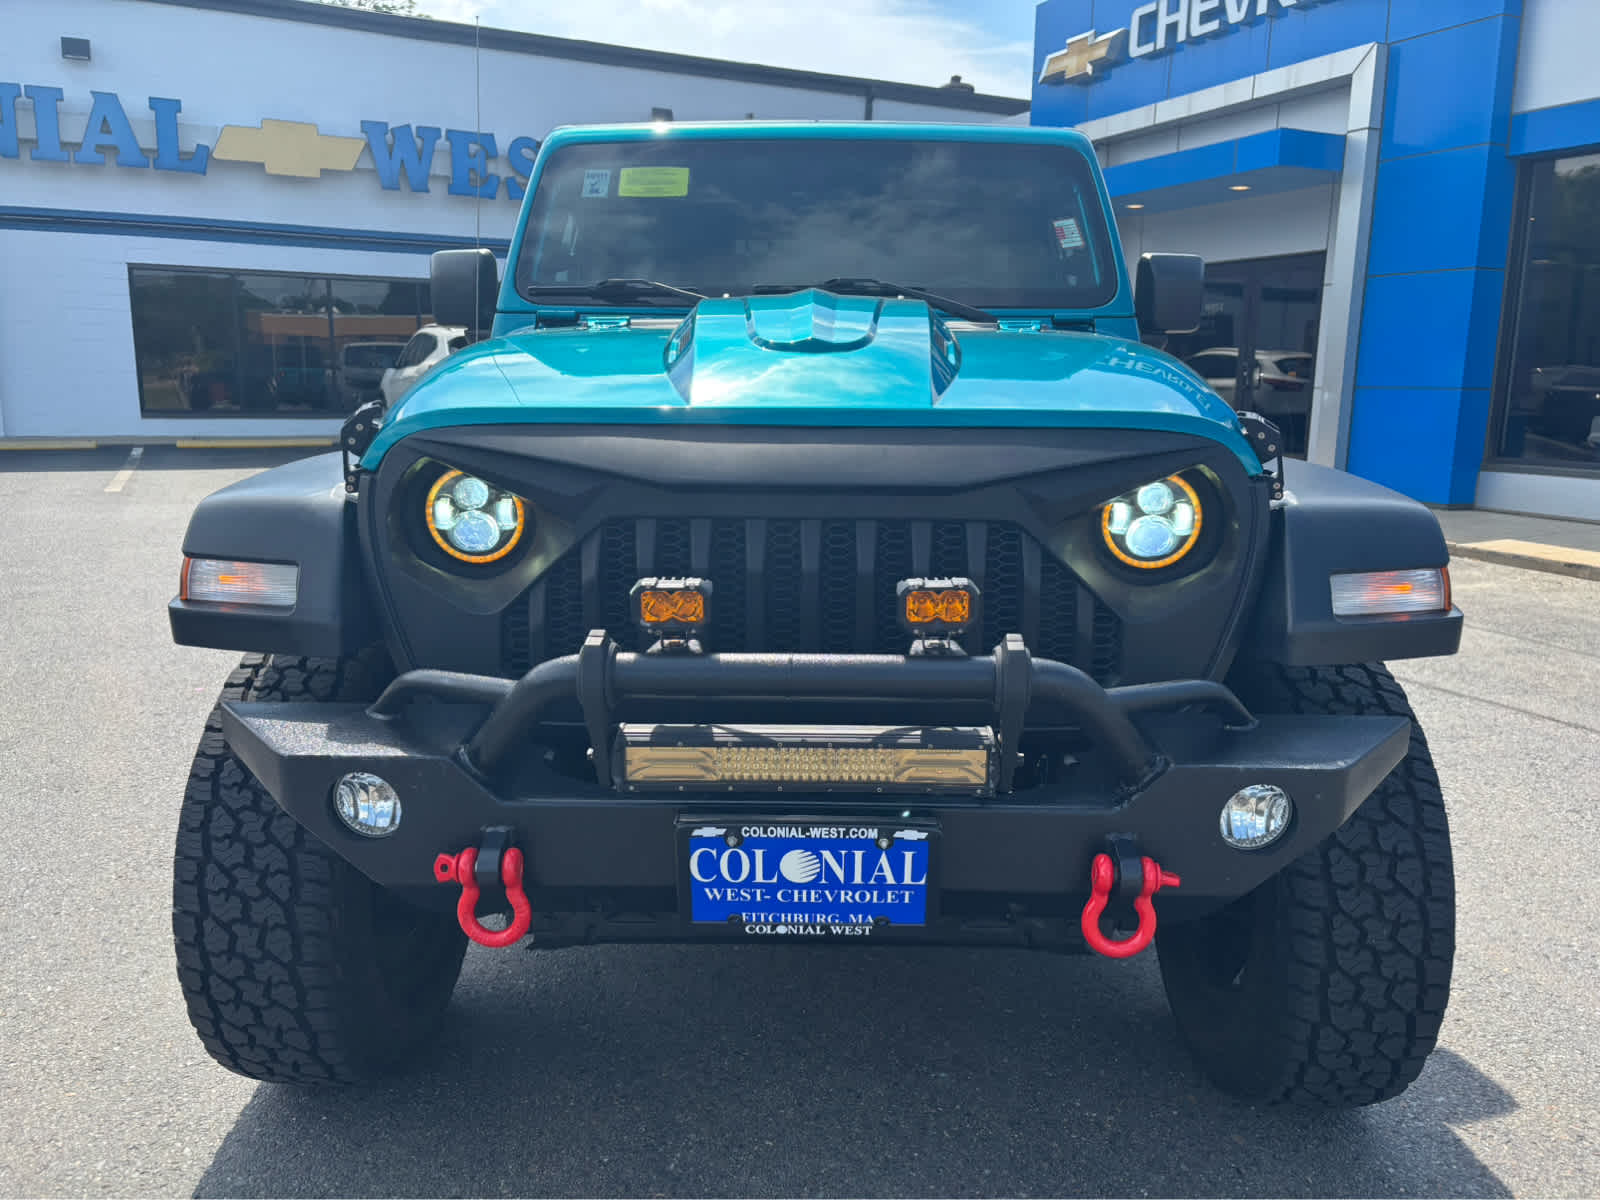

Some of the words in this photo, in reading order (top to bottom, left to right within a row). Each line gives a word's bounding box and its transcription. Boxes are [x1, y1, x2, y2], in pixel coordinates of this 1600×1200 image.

[741, 826, 879, 840] COLONIAL-WEST.COM
[689, 847, 928, 885] COLONIAL
[776, 889, 915, 904] CHEVROLET
[848, 914, 874, 924] MA
[744, 924, 826, 936] COLONIAL
[830, 925, 873, 936] WEST
